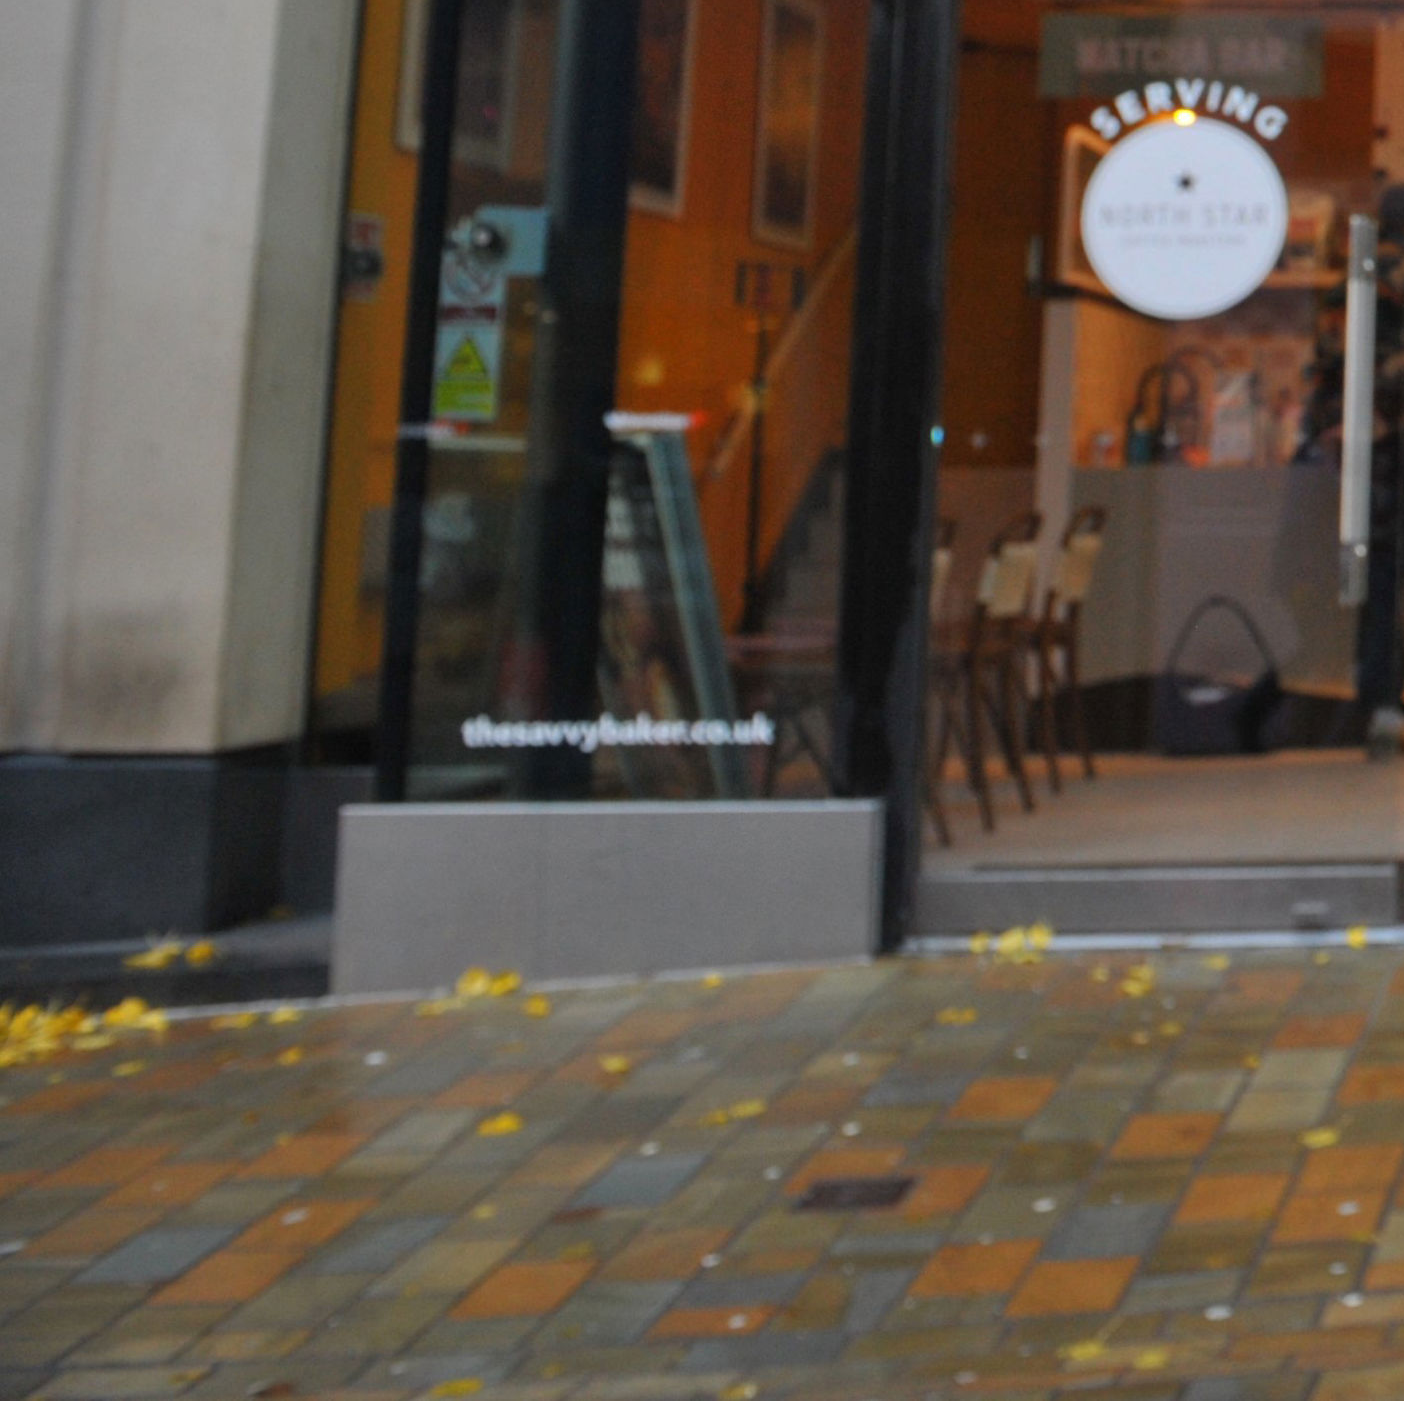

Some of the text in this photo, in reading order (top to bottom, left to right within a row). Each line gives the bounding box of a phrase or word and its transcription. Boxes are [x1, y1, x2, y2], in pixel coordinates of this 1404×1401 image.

[1089, 78, 1289, 141] SERVING
[1101, 202, 1270, 228] NORTH STAR
[461, 710, 776, 753] thesavvybaker.co.uk
